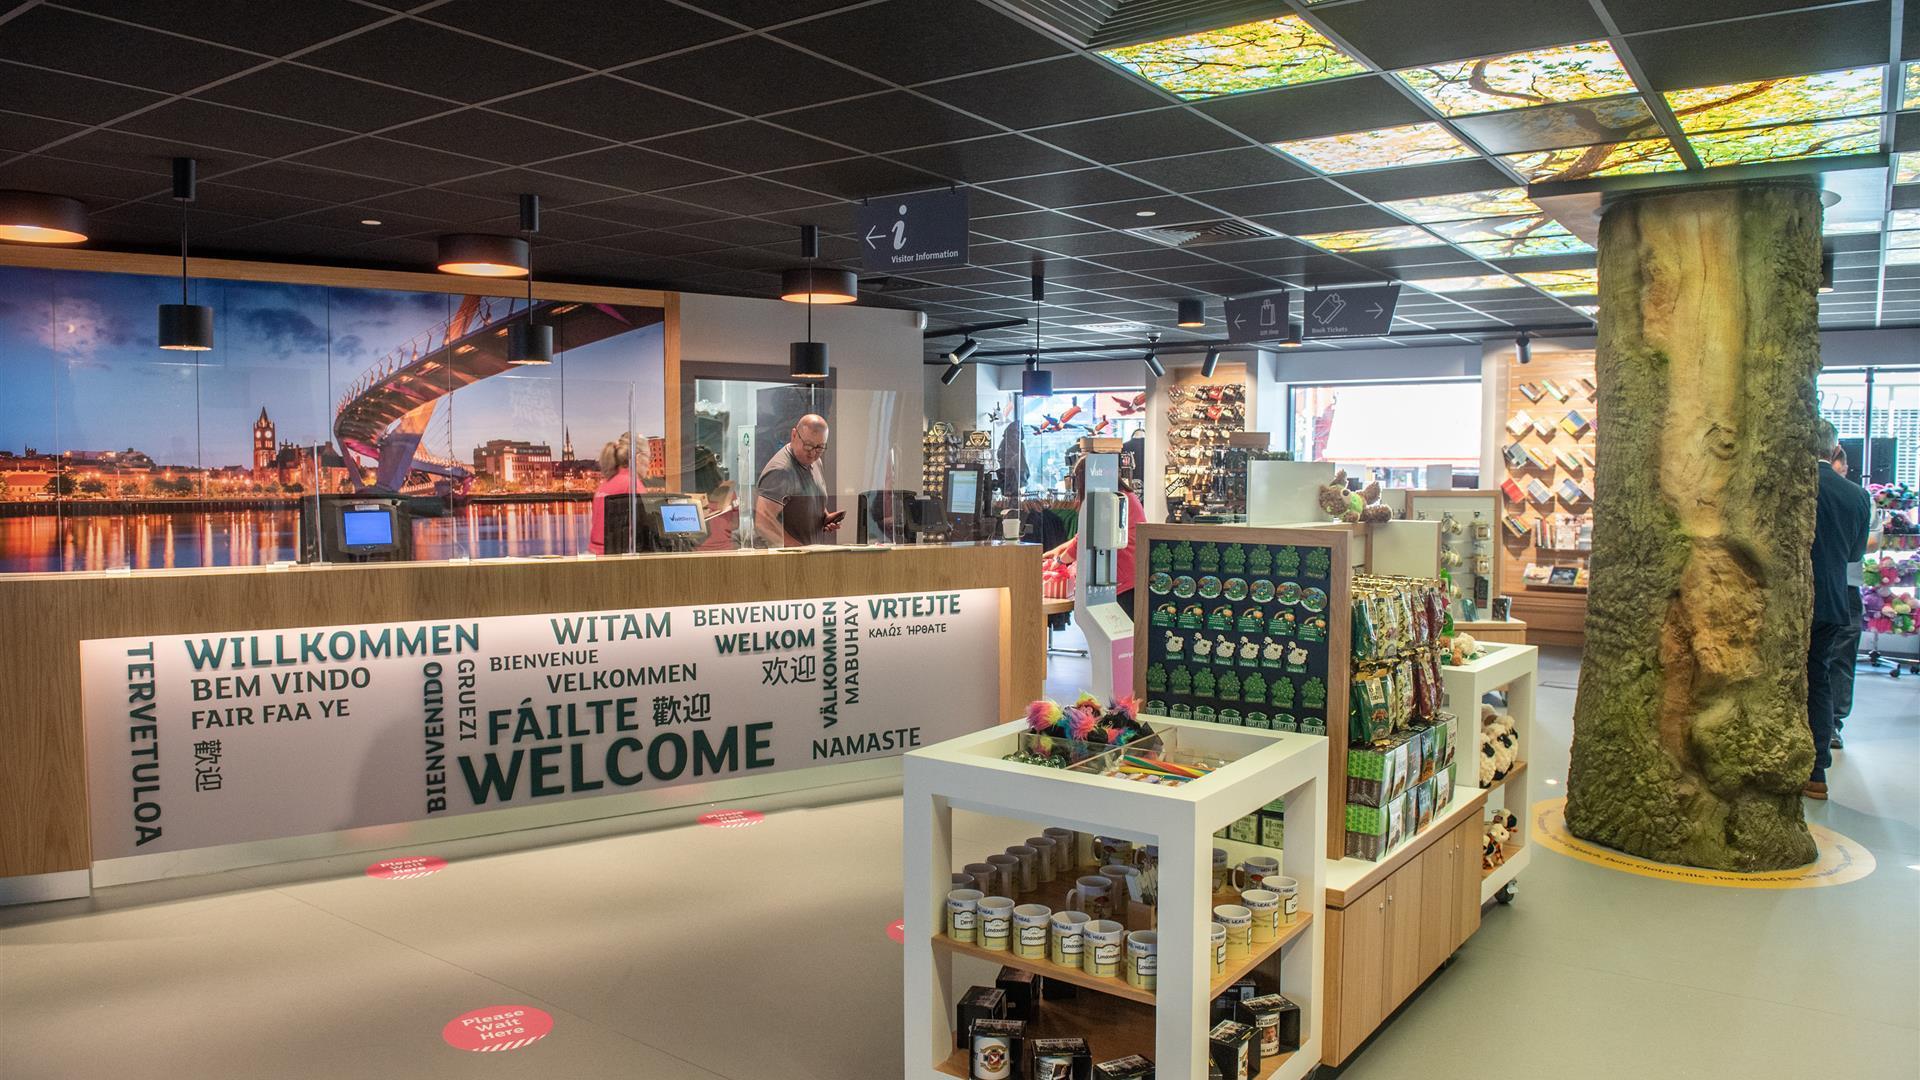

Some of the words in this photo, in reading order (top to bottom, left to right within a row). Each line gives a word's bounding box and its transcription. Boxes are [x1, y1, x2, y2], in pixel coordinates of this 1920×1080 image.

[891, 254, 914, 263] Visitor
[916, 250, 959, 261] Information
[692, 602, 816, 628] BENVENUTO
[867, 593, 961, 620] VRTEJTE
[551, 611, 672, 645] WITAM
[714, 628, 816, 656] WELKOM
[184, 622, 480, 671] WILLKOMMEN
[489, 648, 599, 672] BIENVENUE
[844, 600, 860, 705] MABUHAY
[546, 662, 698, 694] VELKOMMEN
[761, 654, 817, 686] 欢迎
[820, 601, 839, 729] VÄLKOMMEN
[190, 674, 261, 702] BEM
[270, 666, 371, 695] VINDO
[457, 658, 477, 742] GRUEZI
[191, 706, 255, 730] FAIR
[262, 702, 312, 724] FAA
[318, 698, 351, 719] YE
[488, 698, 639, 746] FÁILTE
[652, 692, 712, 728] 歡迎
[126, 641, 163, 848] TERVETULOA
[423, 661, 447, 815] BIENVENIDO
[812, 726, 921, 761] NAMASTE
[456, 720, 776, 806] WELCOME
[462, 1010, 525, 1026] Please
[475, 1018, 522, 1032] Wait
[480, 1027, 525, 1040] Here
